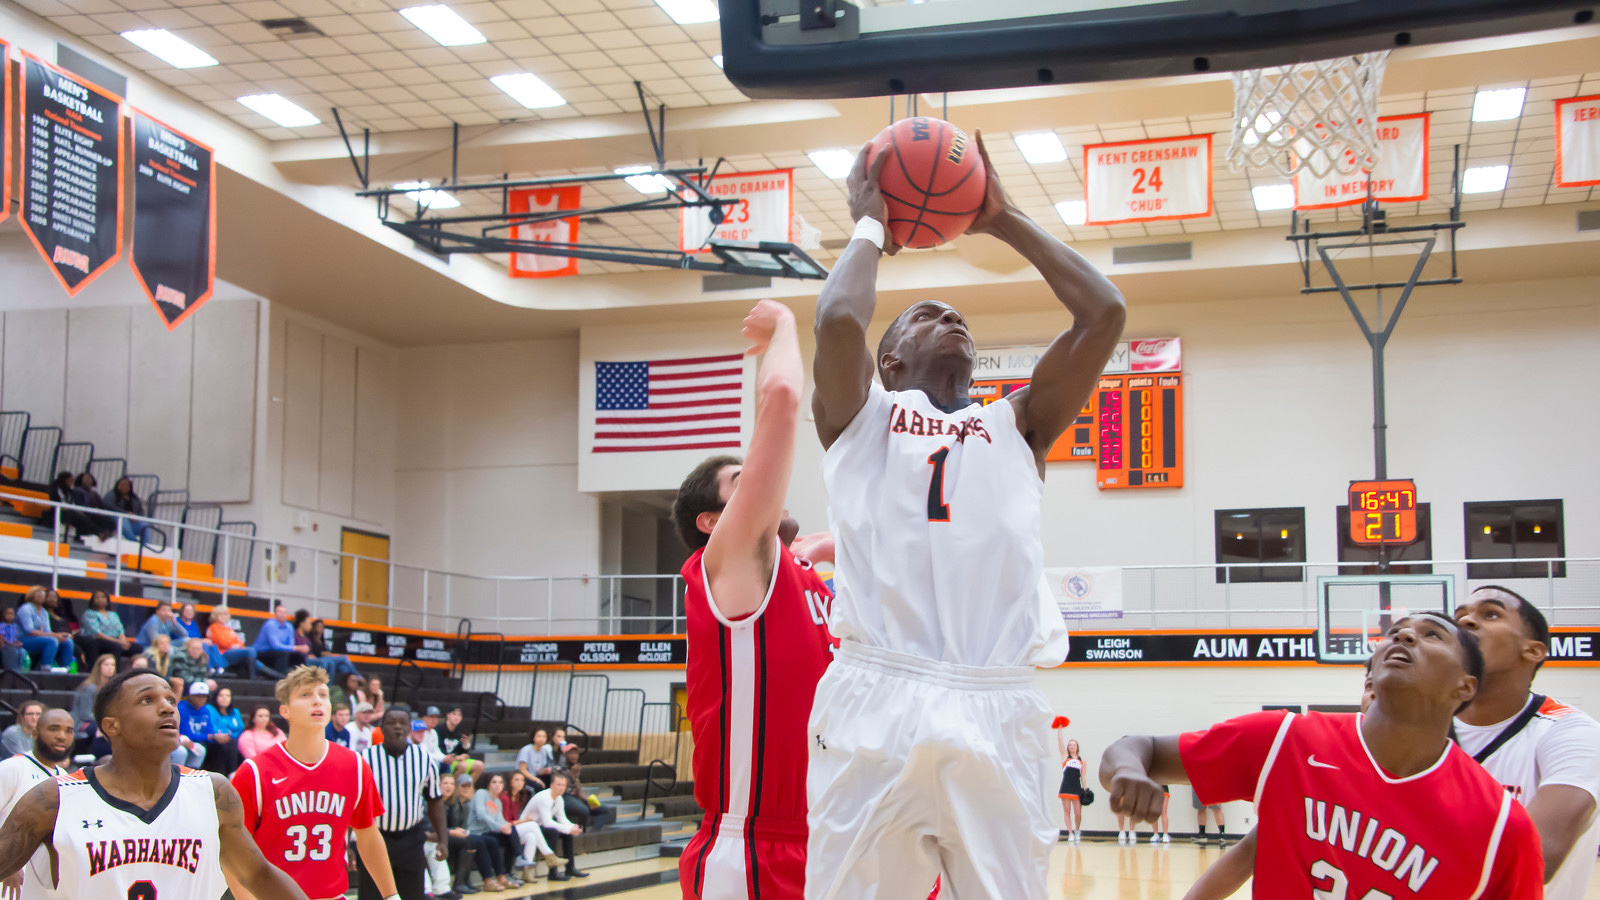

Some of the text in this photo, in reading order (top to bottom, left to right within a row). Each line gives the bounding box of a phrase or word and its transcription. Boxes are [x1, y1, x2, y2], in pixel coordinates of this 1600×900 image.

[58, 77, 88, 101] MEN'S
[43, 84, 104, 123] BASKETBALL
[54, 124, 73, 139] ELITE
[54, 146, 97, 172] APPEARANCE
[147, 136, 199, 171] BASKETBALL
[1098, 146, 1198, 166] KENT CRENSHAW
[54, 157, 97, 182] APPEARANCE
[53, 168, 97, 193] APPEARANCE
[740, 180, 785, 194] GRAHAM
[1131, 166, 1163, 194] 24
[1325, 179, 1395, 197] IN MEMORY
[53, 179, 96, 203] APPEARANCE
[53, 189, 96, 214] APPEARANCE
[1125, 198, 1168, 213] "CHUB"
[53, 200, 96, 224] APPEARANCE
[722, 199, 749, 225] 23
[52, 221, 90, 243] APPEARANCE
[1129, 377, 1153, 388] points
[1159, 376, 1178, 387] fouls
[1106, 391, 1121, 406] 15
[1141, 390, 1152, 405] 0
[1101, 406, 1121, 422] 22
[1141, 406, 1152, 421] 0
[1141, 421, 1152, 436] 0
[1072, 447, 1092, 456] fouls
[1102, 437, 1152, 453] 33 0
[1102, 453, 1152, 469] 35 0
[927, 446, 951, 522] 1
[1360, 490, 1414, 510] 16:47
[1365, 512, 1401, 539] 21
[584, 643, 615, 652] PETER
[640, 642, 671, 652] ELLEN
[1097, 639, 1130, 649] LEIGH
[1193, 638, 1248, 658] AUM
[520, 653, 558, 663] KELLEY
[579, 653, 619, 662] OLSSON
[1086, 650, 1143, 659] SWANSON
[275, 791, 346, 820] UNION
[284, 824, 333, 862] 33
[1304, 796, 1440, 893] UNION
[85, 838, 203, 877] WARHAWKS
